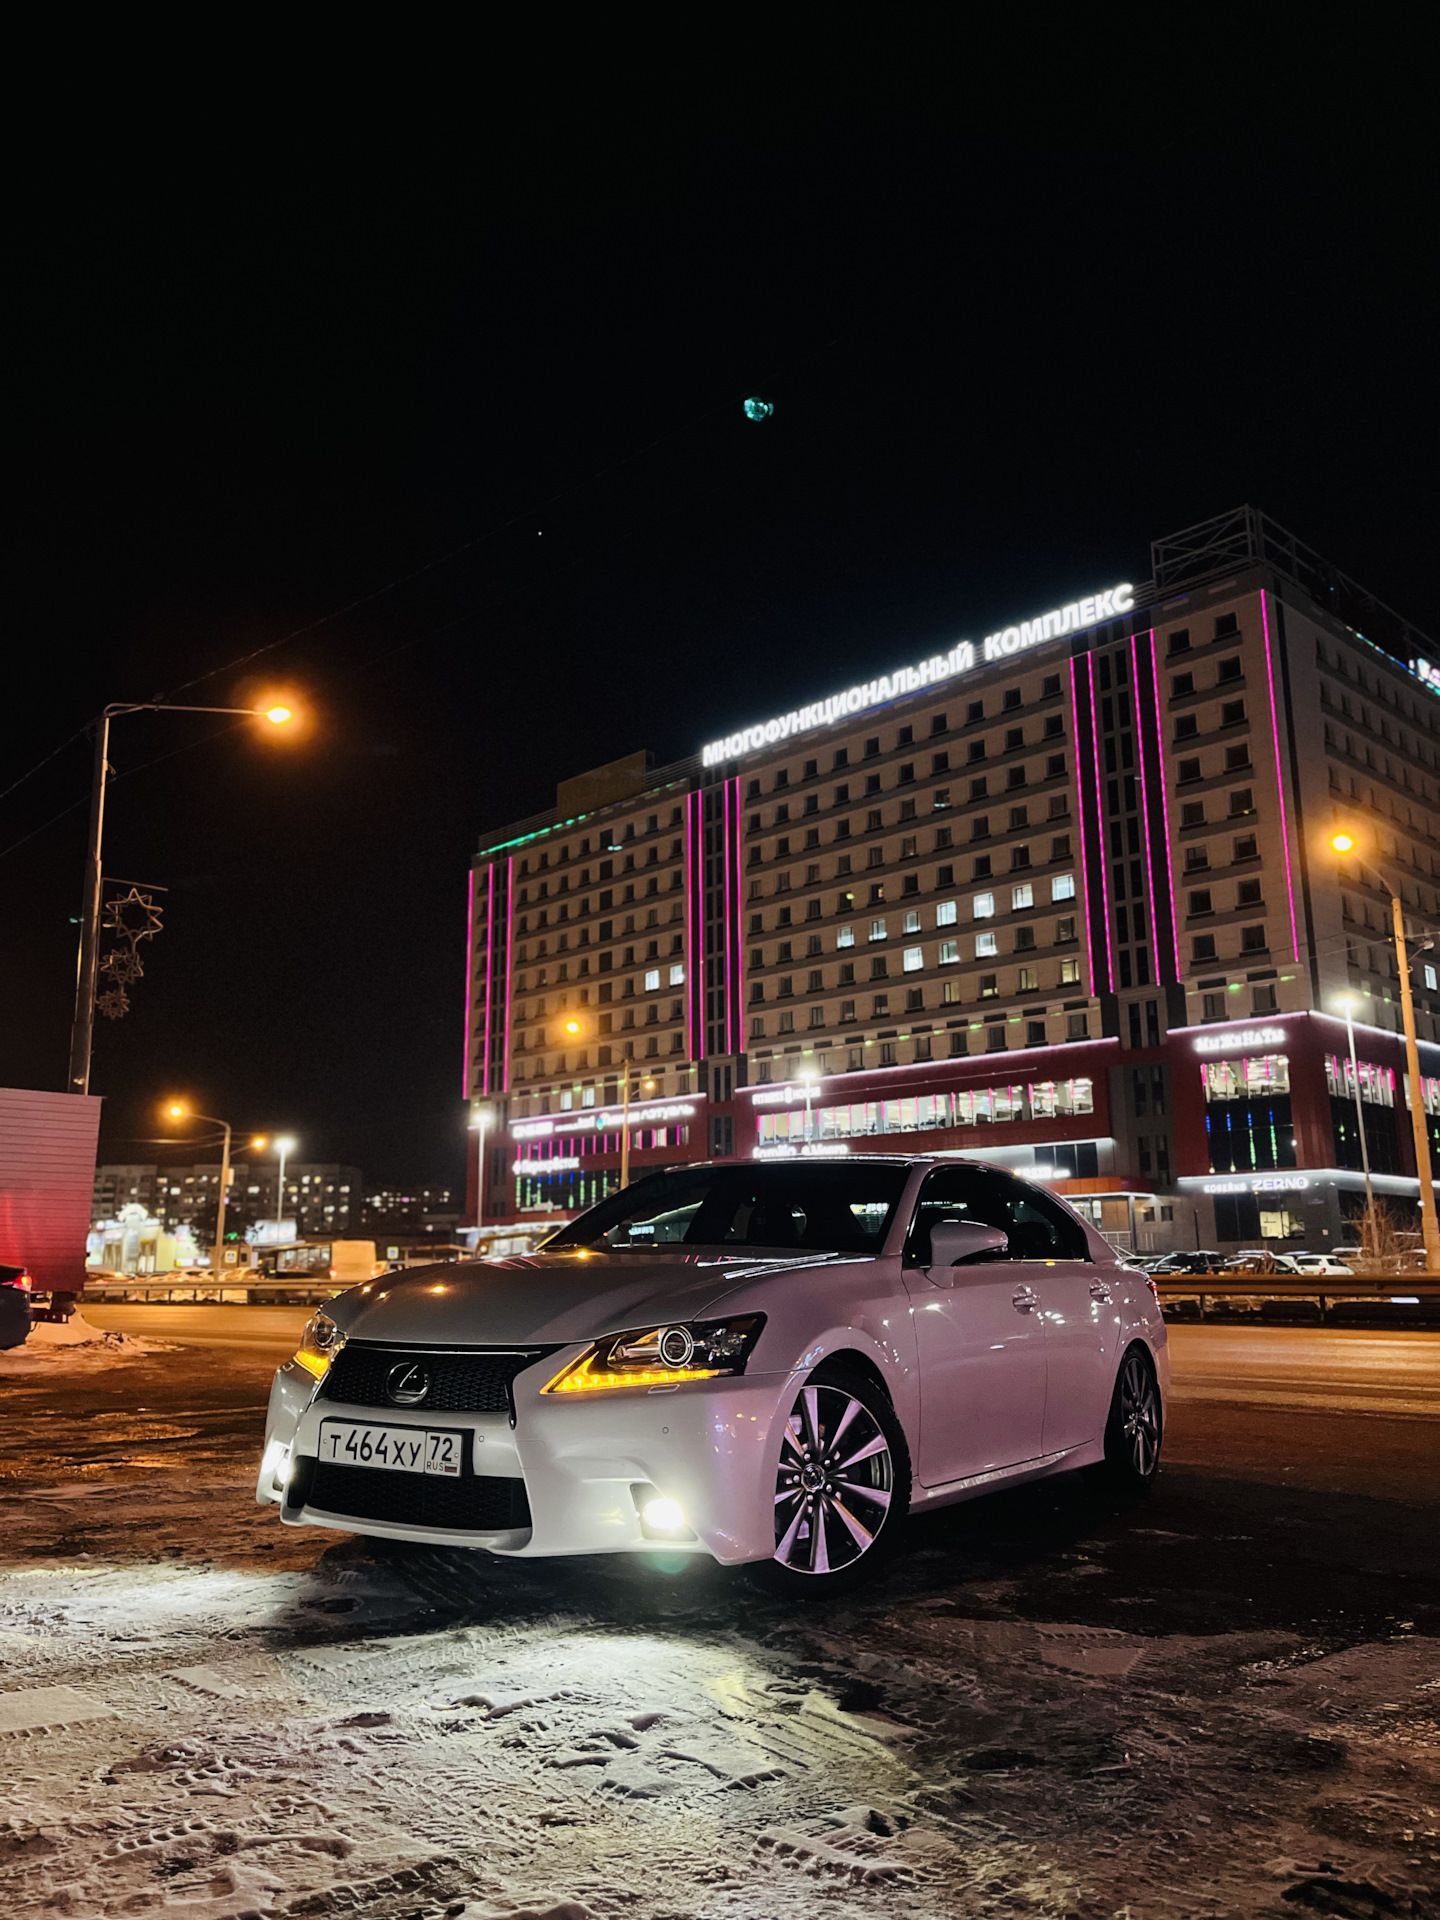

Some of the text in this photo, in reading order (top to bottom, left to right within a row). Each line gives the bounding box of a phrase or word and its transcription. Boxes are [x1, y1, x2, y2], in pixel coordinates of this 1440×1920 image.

[702, 583, 1134, 768] МНОГОФУНКЦИОНАЛЬНЫЙ КОМПЛЕКС
[1251, 1176, 1309, 1191] ZERNO
[430, 1436, 453, 1462] 72
[426, 1461, 444, 1472] RUS
